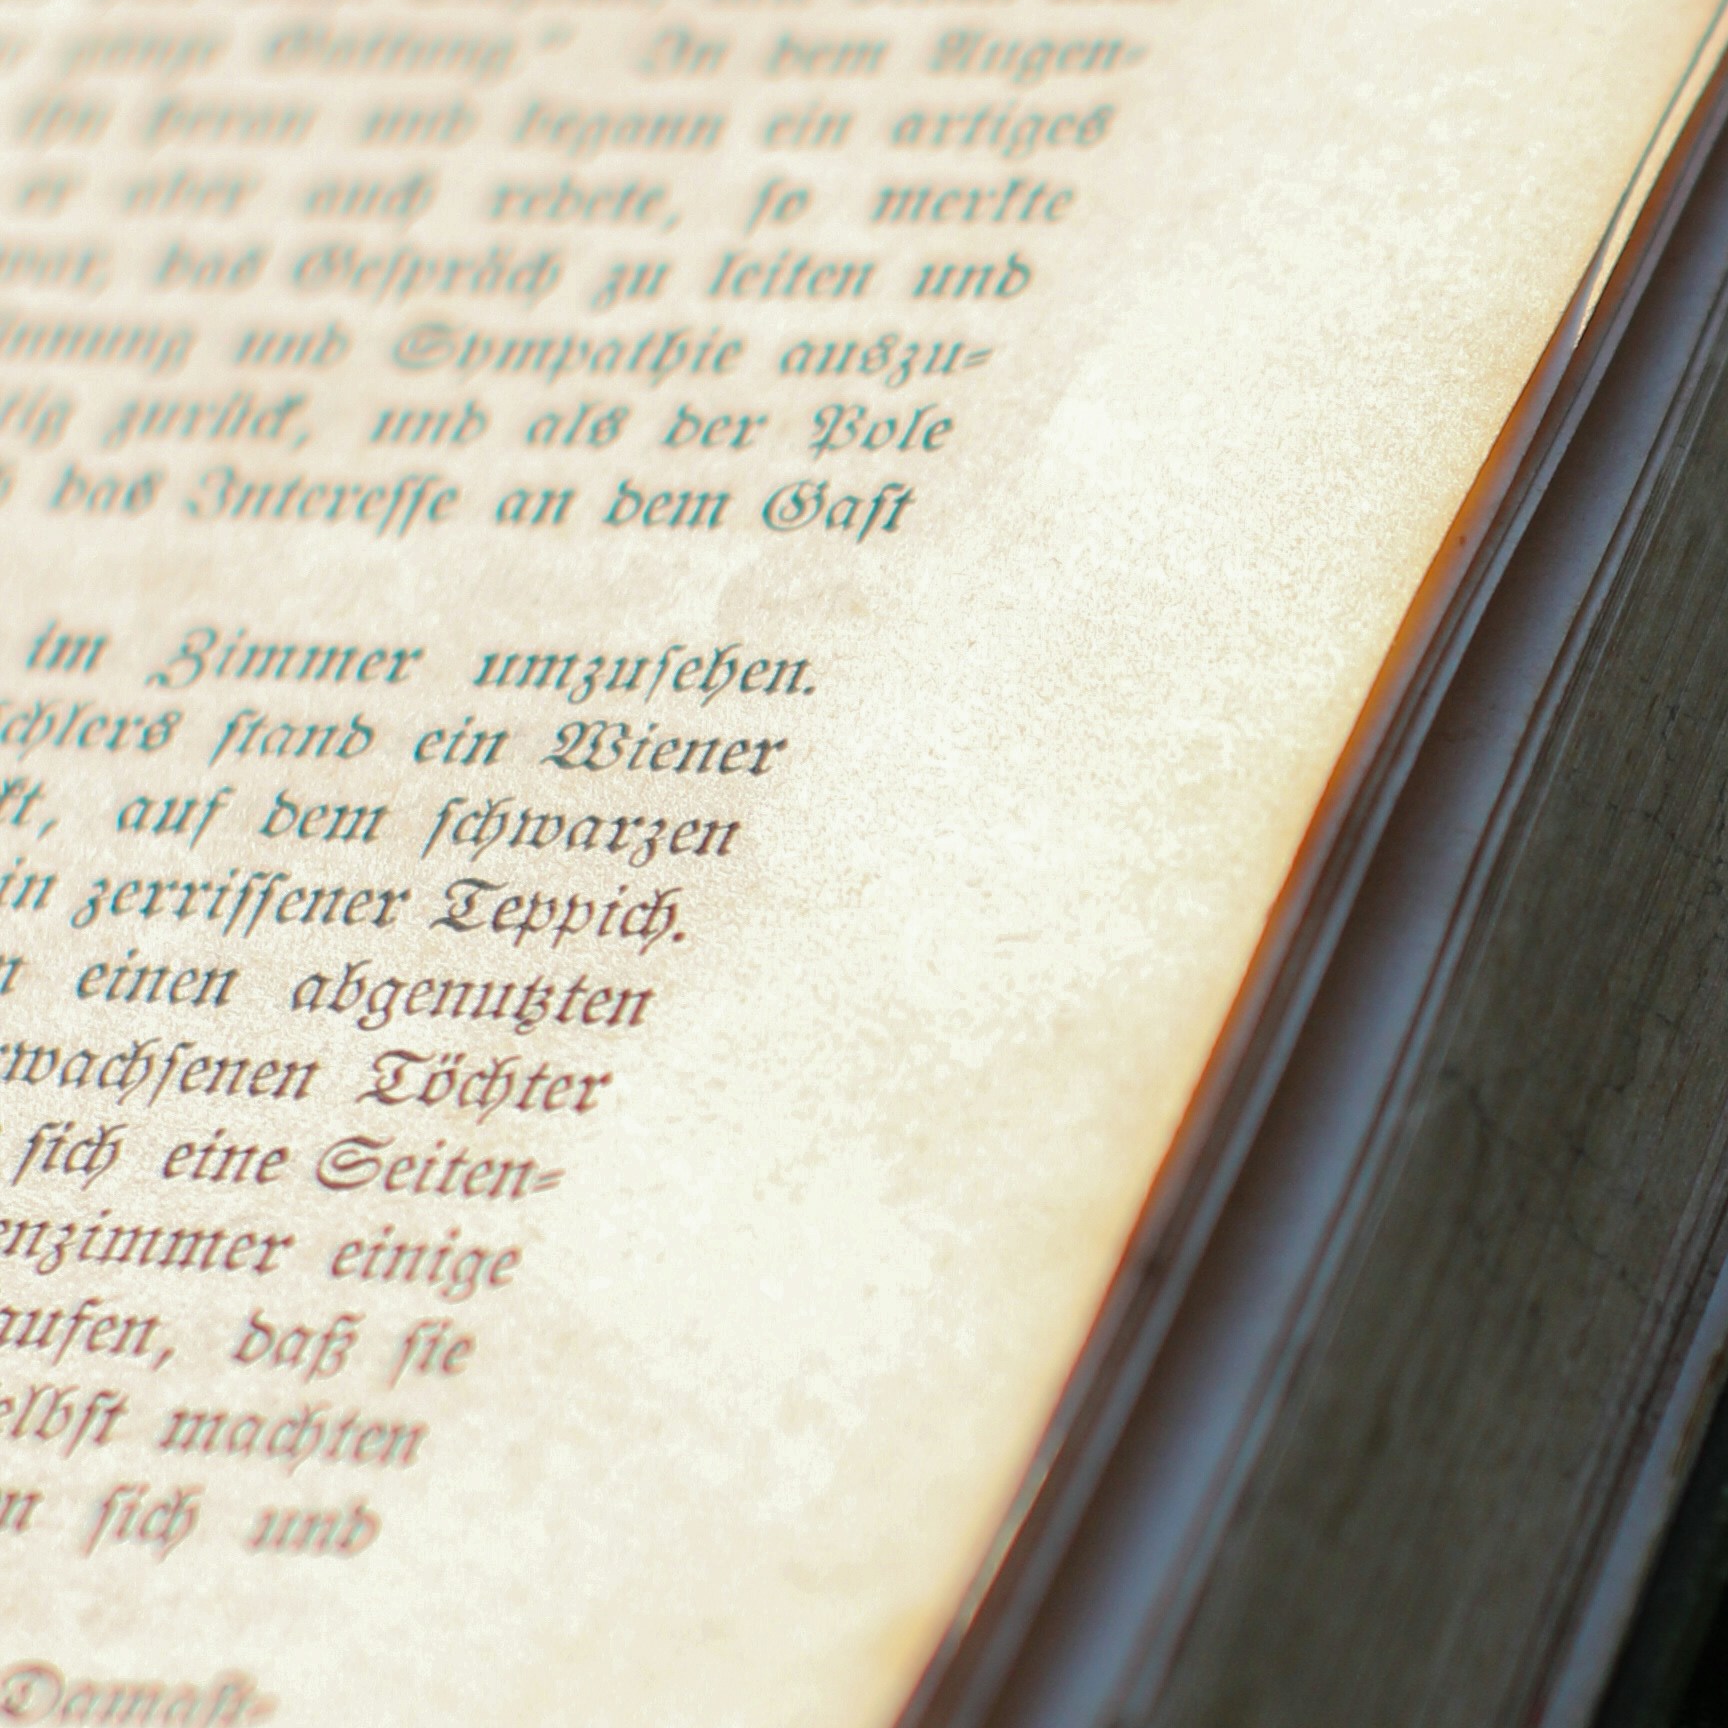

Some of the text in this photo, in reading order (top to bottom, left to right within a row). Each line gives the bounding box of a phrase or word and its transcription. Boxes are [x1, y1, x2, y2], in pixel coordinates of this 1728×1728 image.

[766, 30, 888, 76] dem
[762, 101, 852, 150] ein
[891, 100, 1116, 160] artiges
[871, 176, 1076, 226] merkte
[590, 258, 671, 312] zu
[707, 246, 876, 300] leiten
[912, 252, 1033, 301] und
[233, 319, 351, 368] und
[367, 396, 491, 446] und
[524, 403, 631, 450] als
[660, 403, 767, 451] der
[810, 403, 956, 460] Pole
[48, 462, 165, 514] das
[493, 484, 576, 527] an
[605, 478, 730, 530] dem
[24, 618, 108, 673] im
[143, 624, 425, 690] Zimmer
[0, 696, 184, 763] chlers
[412, 717, 511, 768] ein
[539, 719, 788, 777] Wiener
[115, 782, 237, 850] auf
[259, 792, 389, 845] dem
[429, 877, 687, 953] Teppich.
[75, 946, 241, 1009] einen
[290, 960, 659, 1034] abgenutzten
[0, 1036, 615, 1124] wachſenen Töchter
[162, 1127, 291, 1186] eine
[330, 1223, 523, 1303] einige
[231, 1307, 366, 1384] daß
[157, 1397, 430, 1478] machten
[242, 1496, 383, 1558] und
